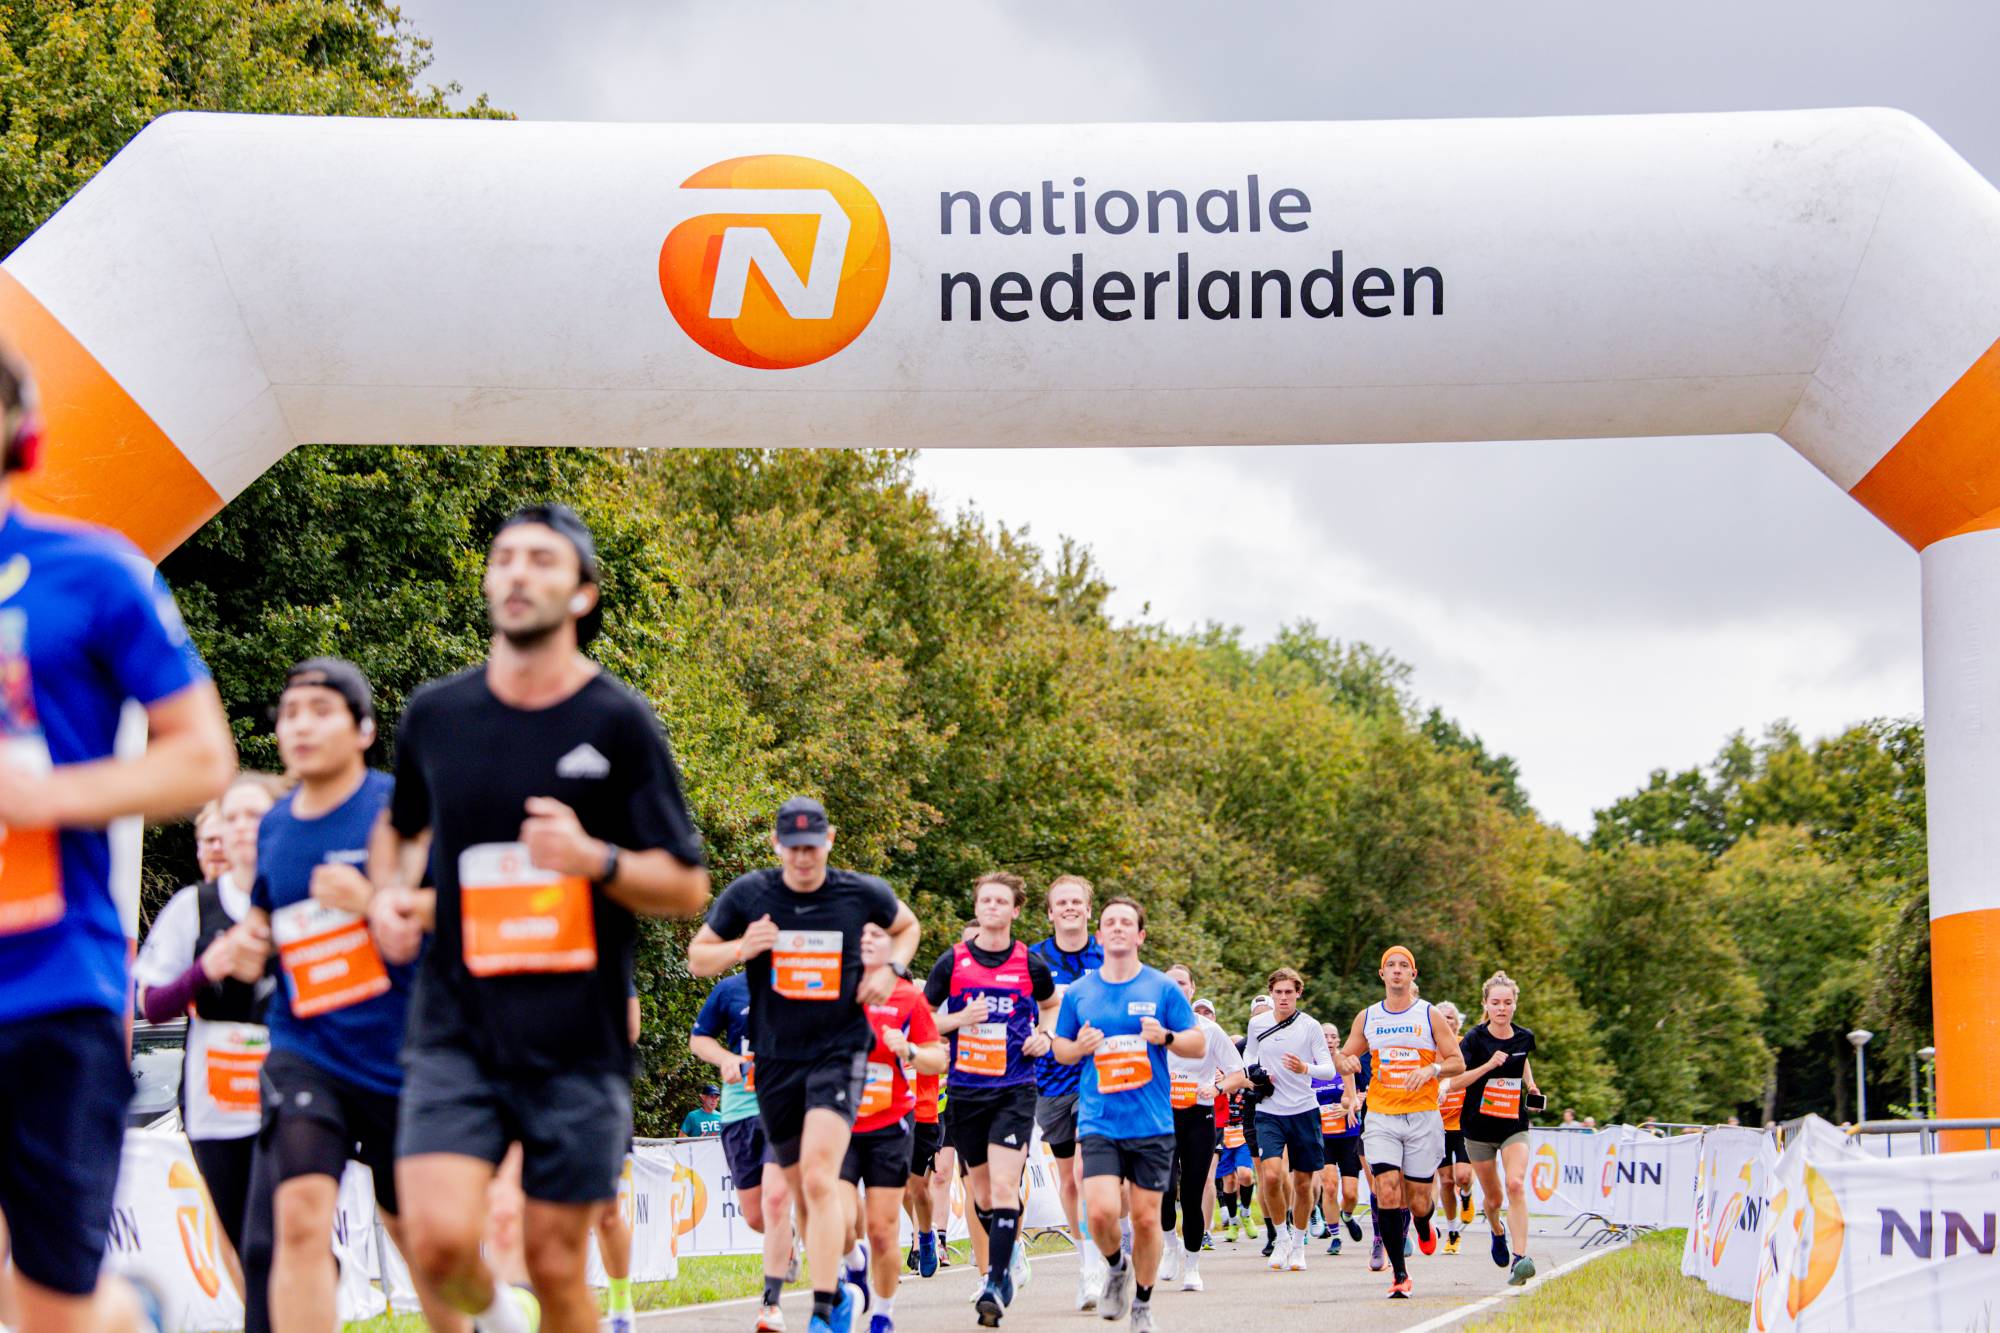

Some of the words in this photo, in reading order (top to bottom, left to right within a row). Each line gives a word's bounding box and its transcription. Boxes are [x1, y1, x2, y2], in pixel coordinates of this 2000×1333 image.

[939, 174, 1312, 235] nationale
[940, 250, 1445, 322] nederlanden
[1564, 1164, 1584, 1185] NN
[1617, 1161, 1662, 1185] NN
[636, 1193, 649, 1225] NN
[1876, 1207, 1996, 1259] NN
